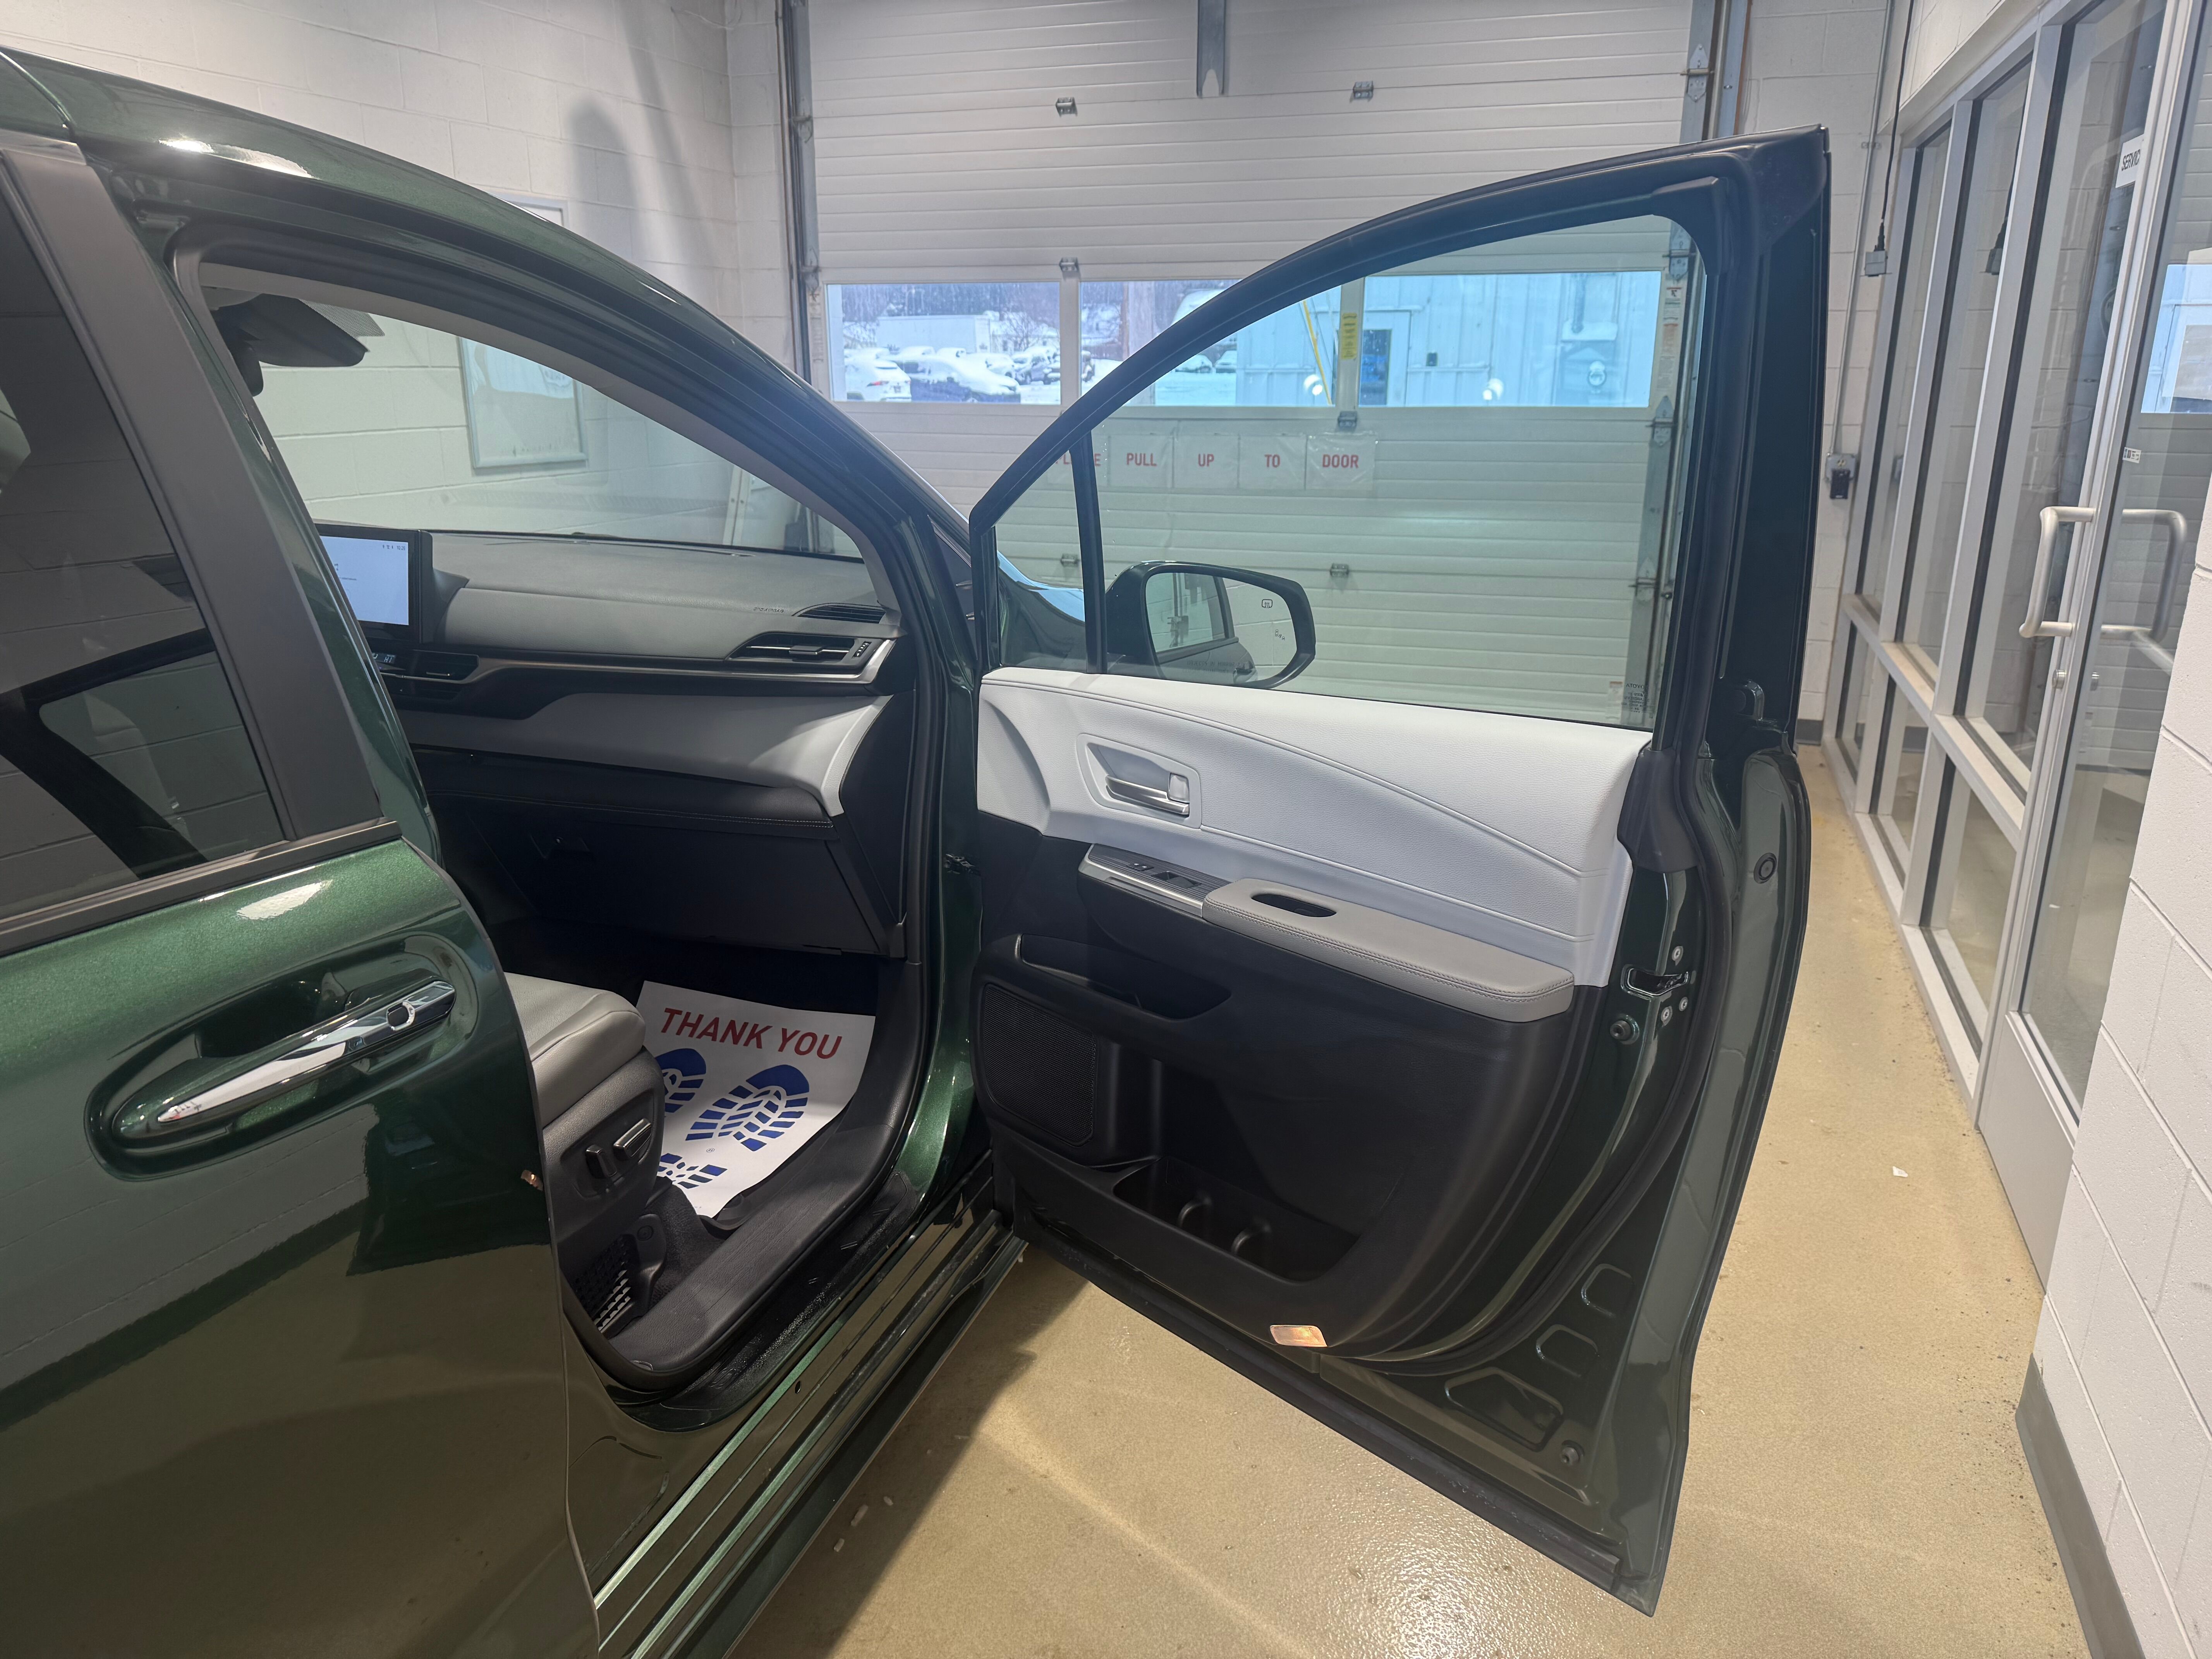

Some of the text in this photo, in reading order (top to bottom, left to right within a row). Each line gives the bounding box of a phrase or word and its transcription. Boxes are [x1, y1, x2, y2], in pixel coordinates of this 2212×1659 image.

[2121, 149, 2141, 171] SERVIC
[1127, 453, 1359, 468] PULL UP TO DOOR
[661, 1007, 843, 1060] THANK YOU
